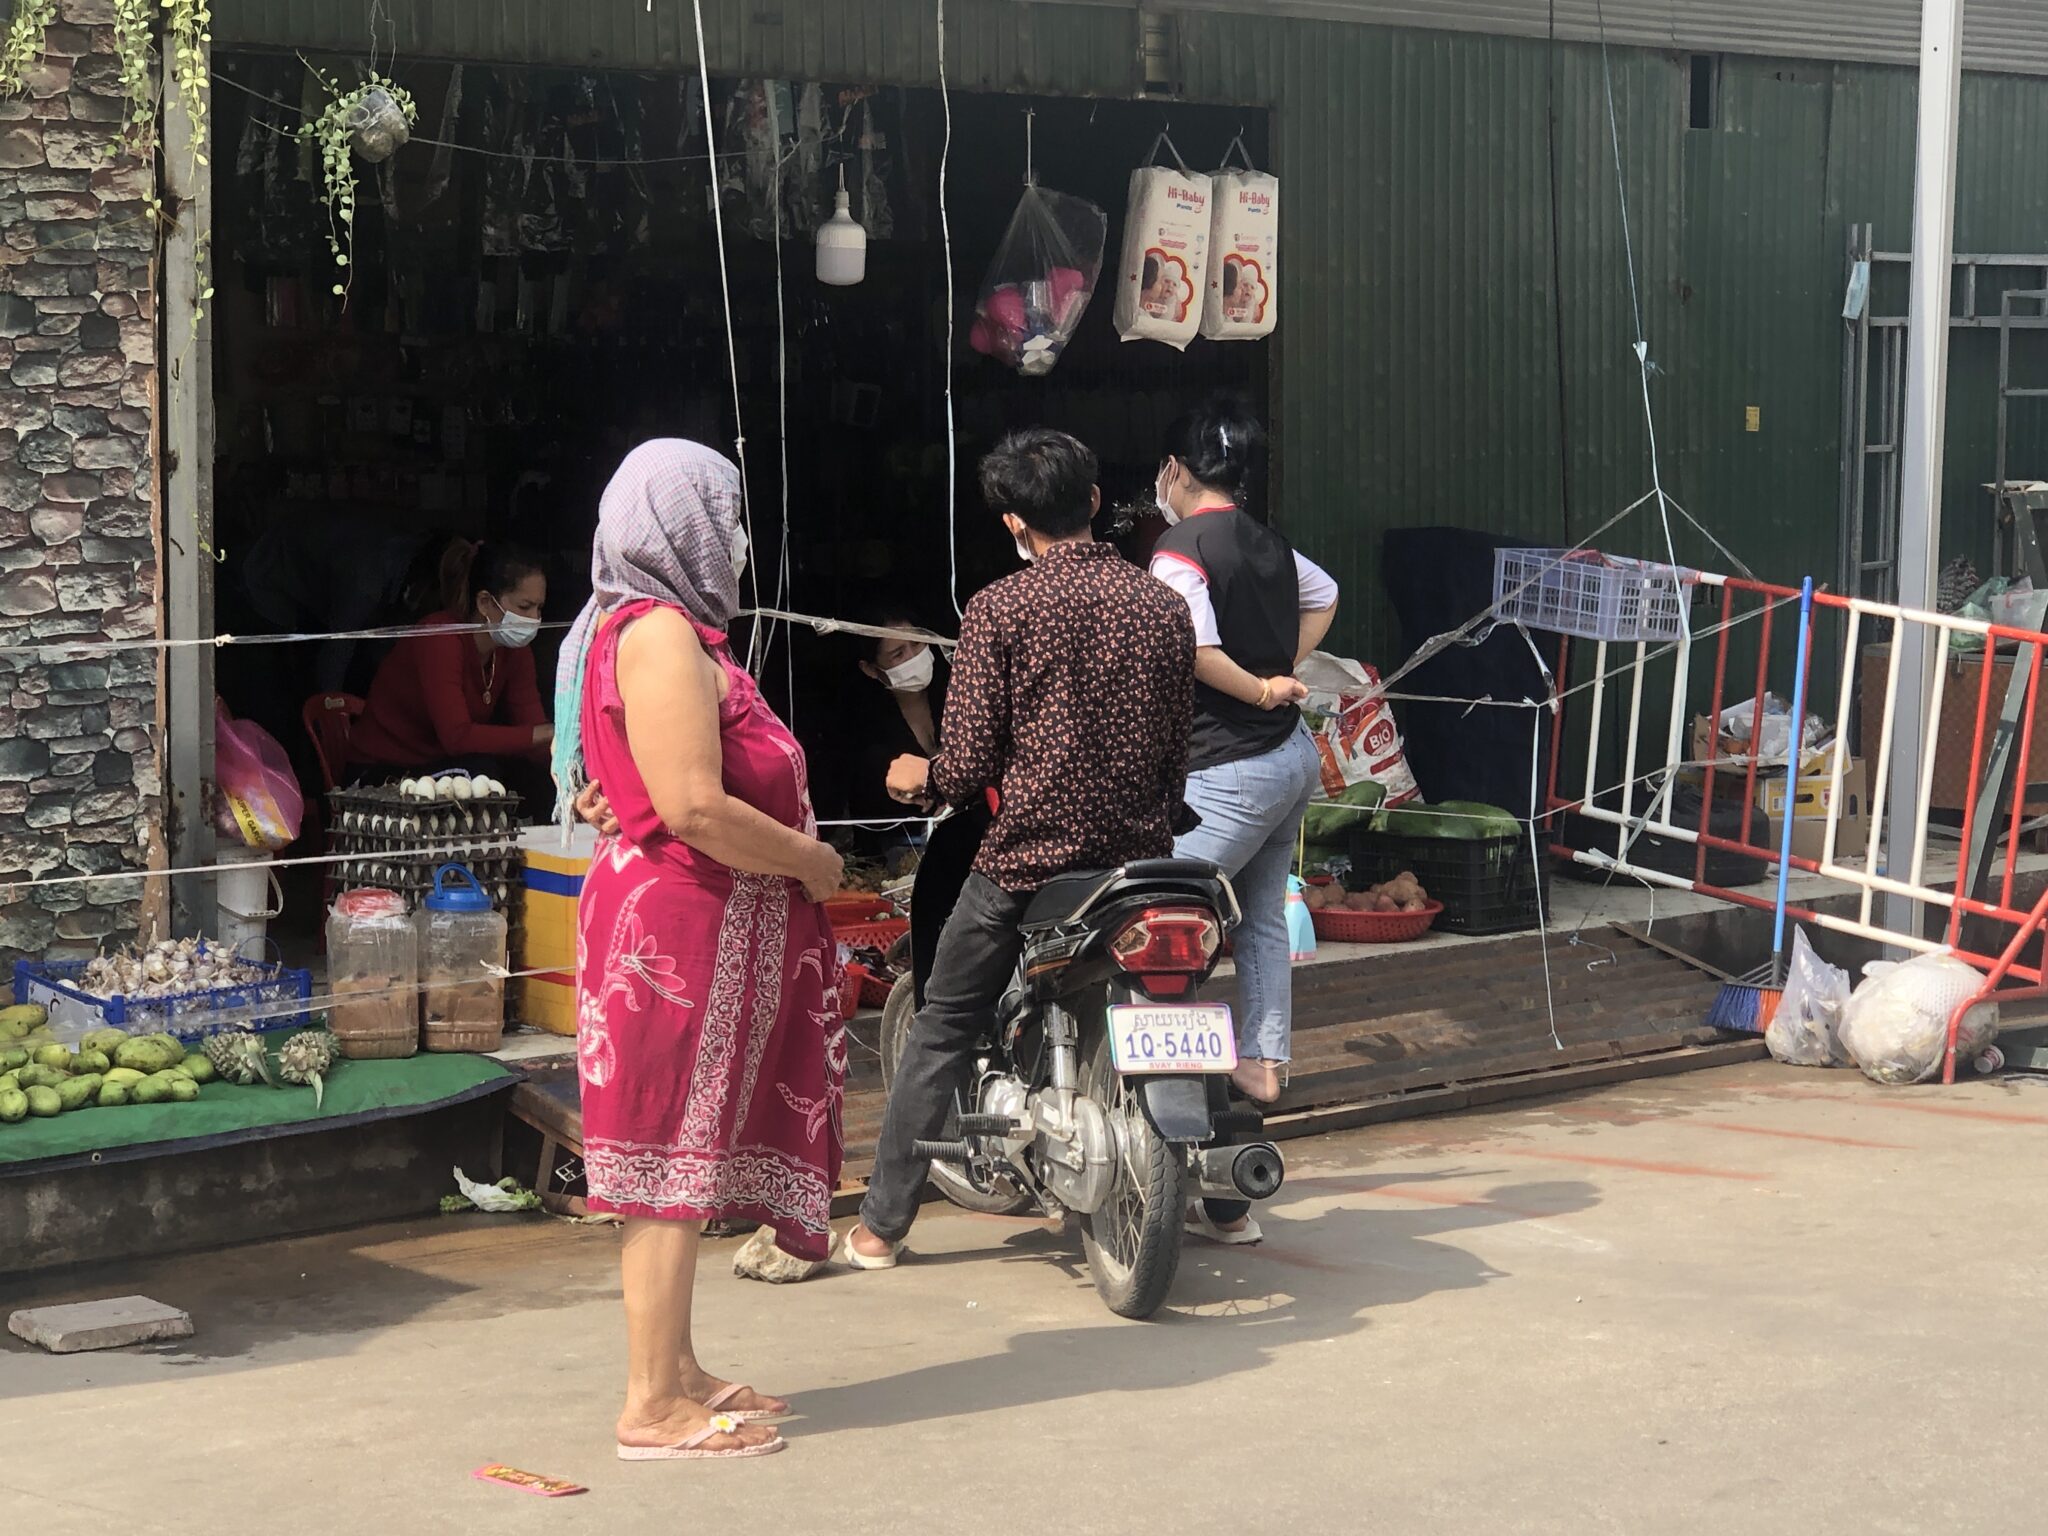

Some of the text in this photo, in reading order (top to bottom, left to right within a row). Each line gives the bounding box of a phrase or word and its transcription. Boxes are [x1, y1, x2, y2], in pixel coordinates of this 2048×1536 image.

[1167, 185, 1205, 206] Hi-Baby
[1239, 191, 1270, 207] Hi-Baby
[1126, 1032, 1222, 1059] 1Q-5440
[1149, 1061, 1203, 1070] SVAY RIENG
